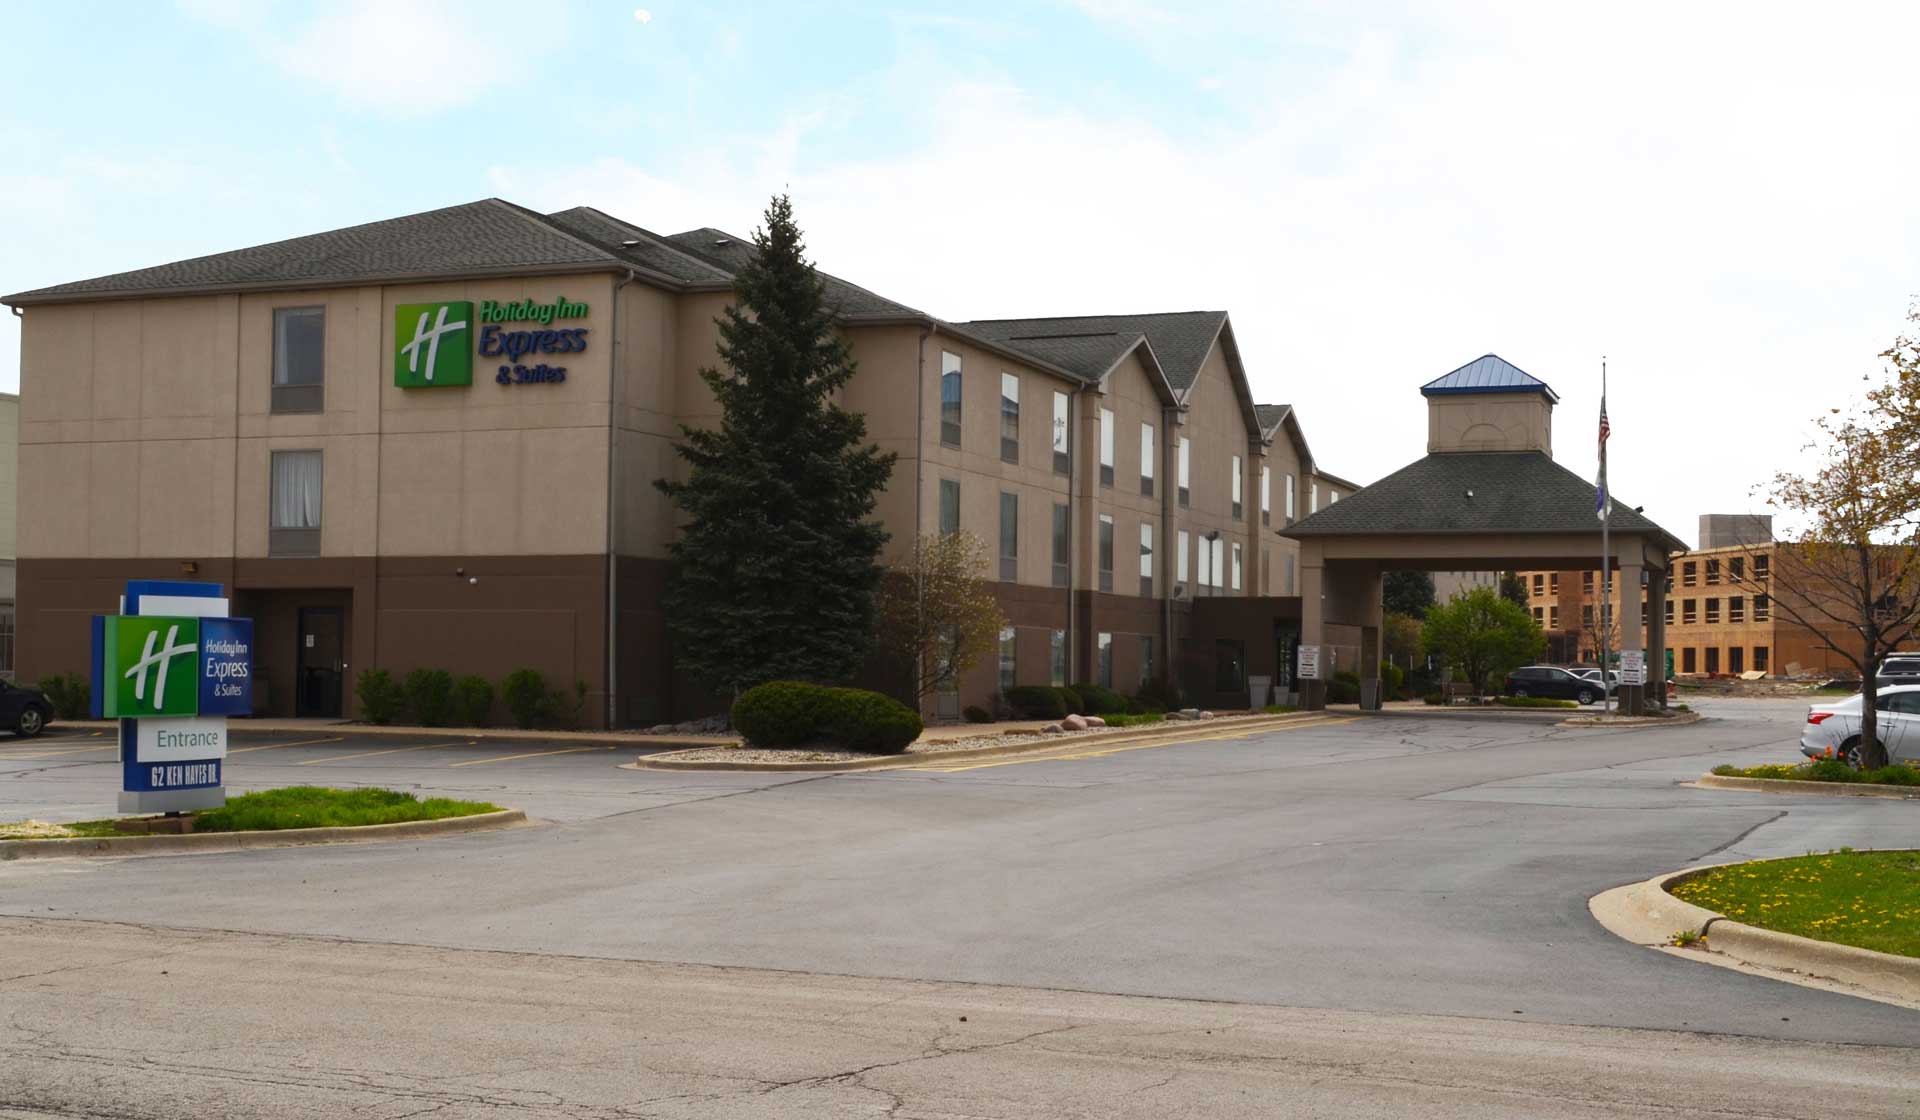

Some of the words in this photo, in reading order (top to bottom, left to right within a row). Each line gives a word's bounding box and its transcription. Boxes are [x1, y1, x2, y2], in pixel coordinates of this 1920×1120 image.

[479, 298, 555, 325] Holiday
[555, 296, 588, 320] Inn
[478, 325, 588, 363] Express
[496, 365, 511, 385] &
[512, 363, 567, 384] Suites
[206, 639, 235, 656] Holiday
[235, 639, 248, 654] Inn
[206, 657, 248, 683] Express
[214, 683, 221, 697] &
[221, 683, 242, 696] Suites
[157, 729, 219, 748] Entrance
[151, 766, 164, 787] 62
[166, 765, 183, 786] KEN
[185, 764, 207, 785] HAYES
